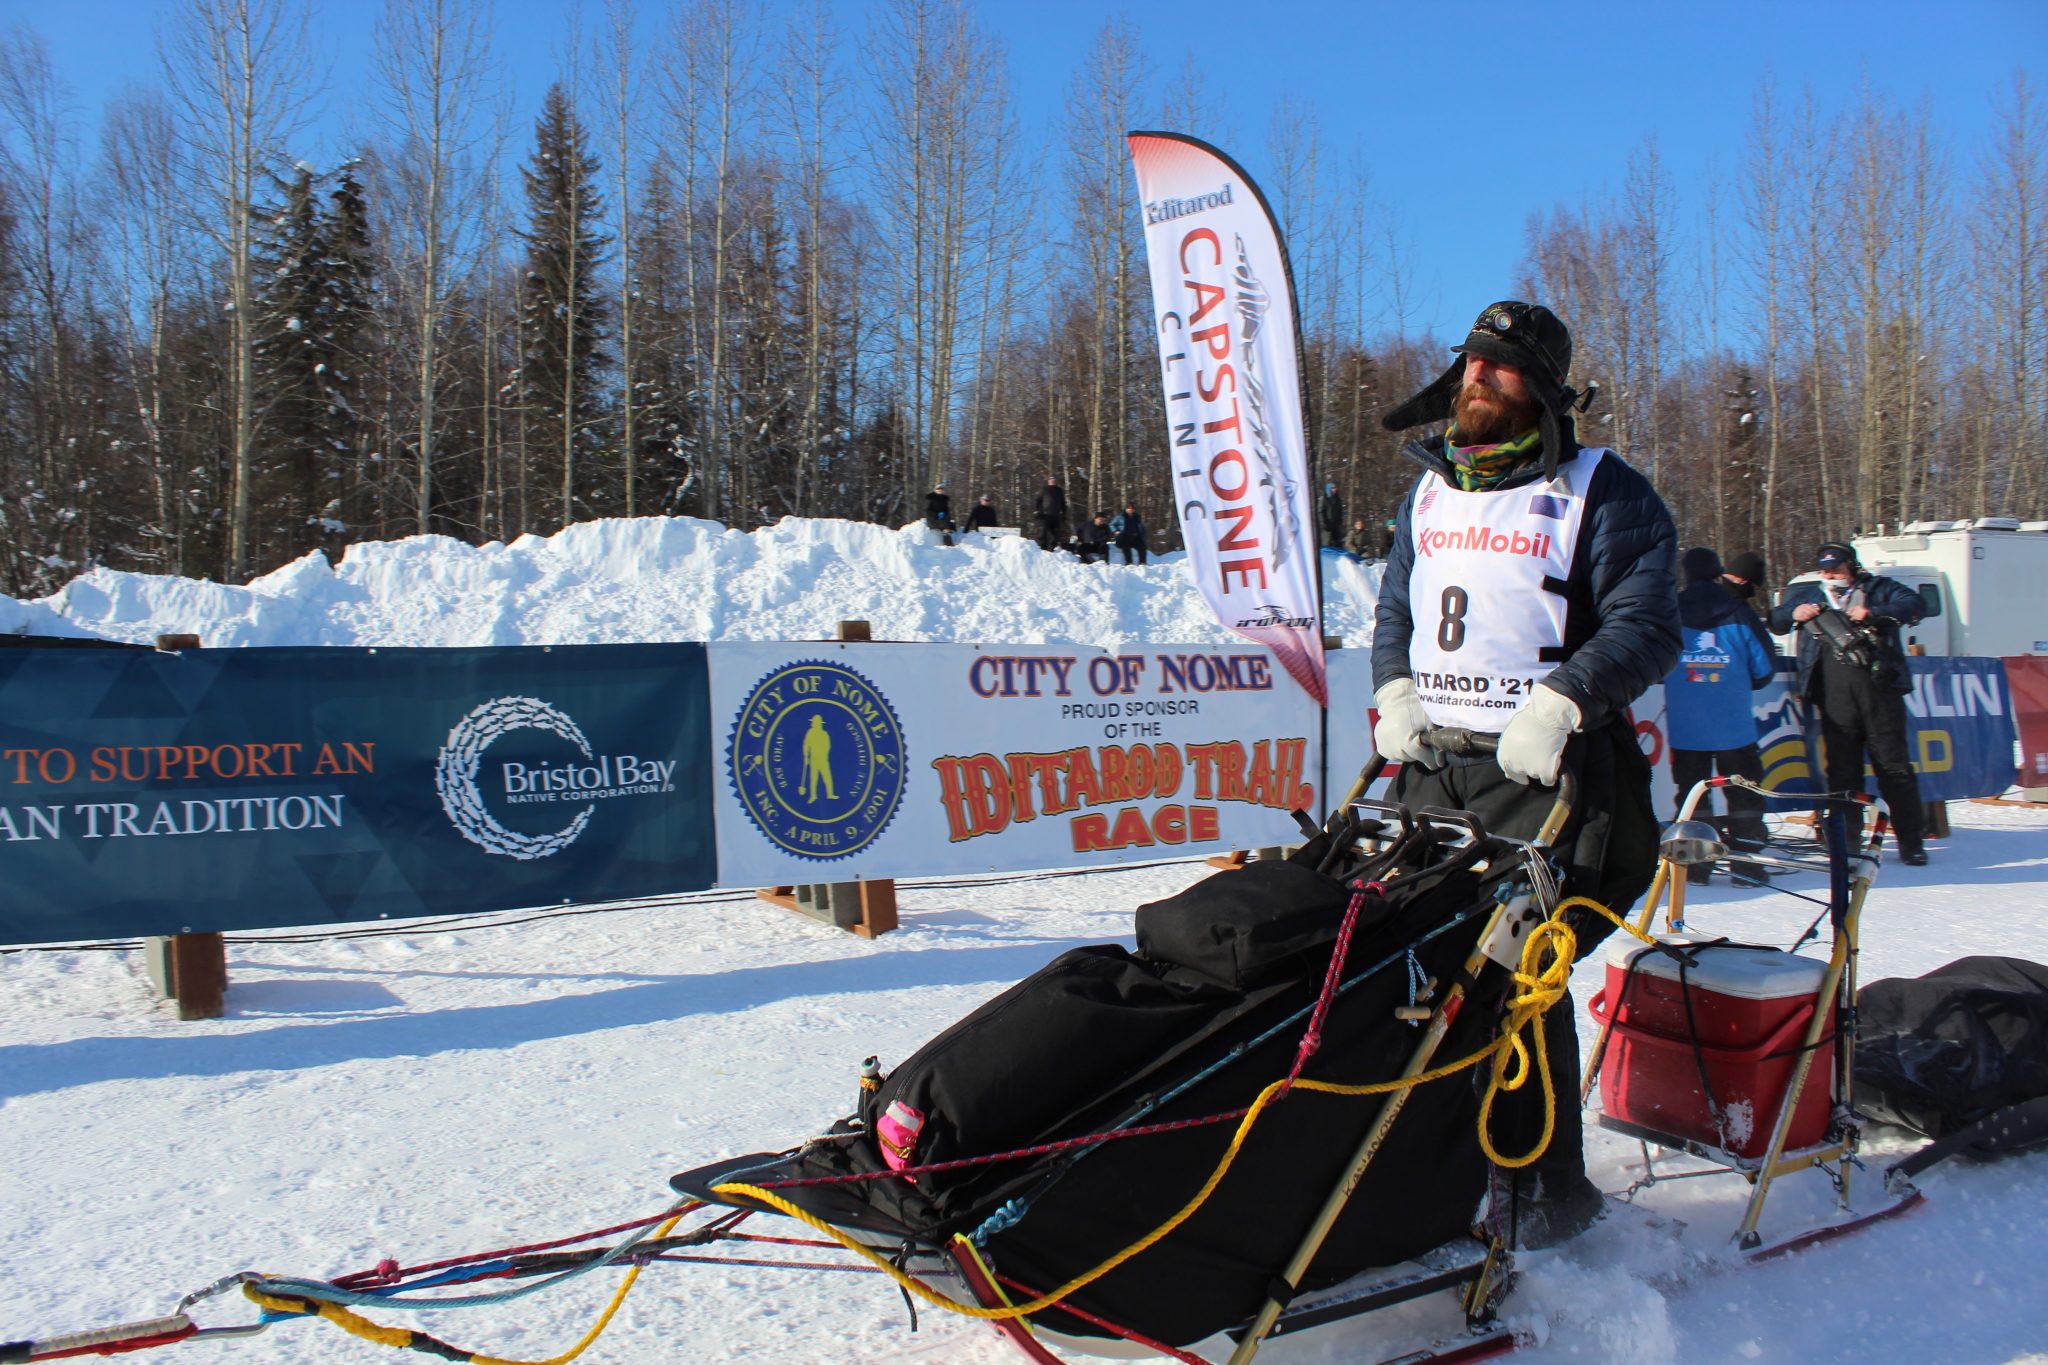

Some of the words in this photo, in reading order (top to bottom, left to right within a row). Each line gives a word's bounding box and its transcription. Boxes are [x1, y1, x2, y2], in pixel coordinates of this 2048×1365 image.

[1161, 311, 1206, 521] CLINIC
[1180, 227, 1267, 595] CAPSTONE
[1437, 585, 1468, 652] 8
[969, 655, 1077, 698] CITY
[1088, 655, 1146, 697] OF
[1156, 653, 1273, 695] NOME
[748, 686, 785, 738] CITY
[793, 675, 822, 694] OF
[831, 679, 889, 739] NOME
[1062, 703, 1120, 719] PROUD
[1125, 700, 1199, 717] SPONSOR
[1104, 723, 1127, 739] OF
[1132, 722, 1161, 737] THE
[4, 747, 77, 784] TO
[89, 743, 303, 782] SUPPORT
[312, 742, 376, 775] AN
[502, 755, 611, 793] Bristol
[615, 755, 677, 792] Bay
[507, 792, 557, 804] NATIVE
[561, 784, 659, 801] CORPORATION
[932, 743, 1183, 842] IDITAROD
[1184, 737, 1314, 812] TRAIL
[75, 794, 346, 838] TRADITION
[784, 825, 840, 846] APRIL
[863, 788, 889, 824] 1901
[1070, 803, 1220, 852] RACE
